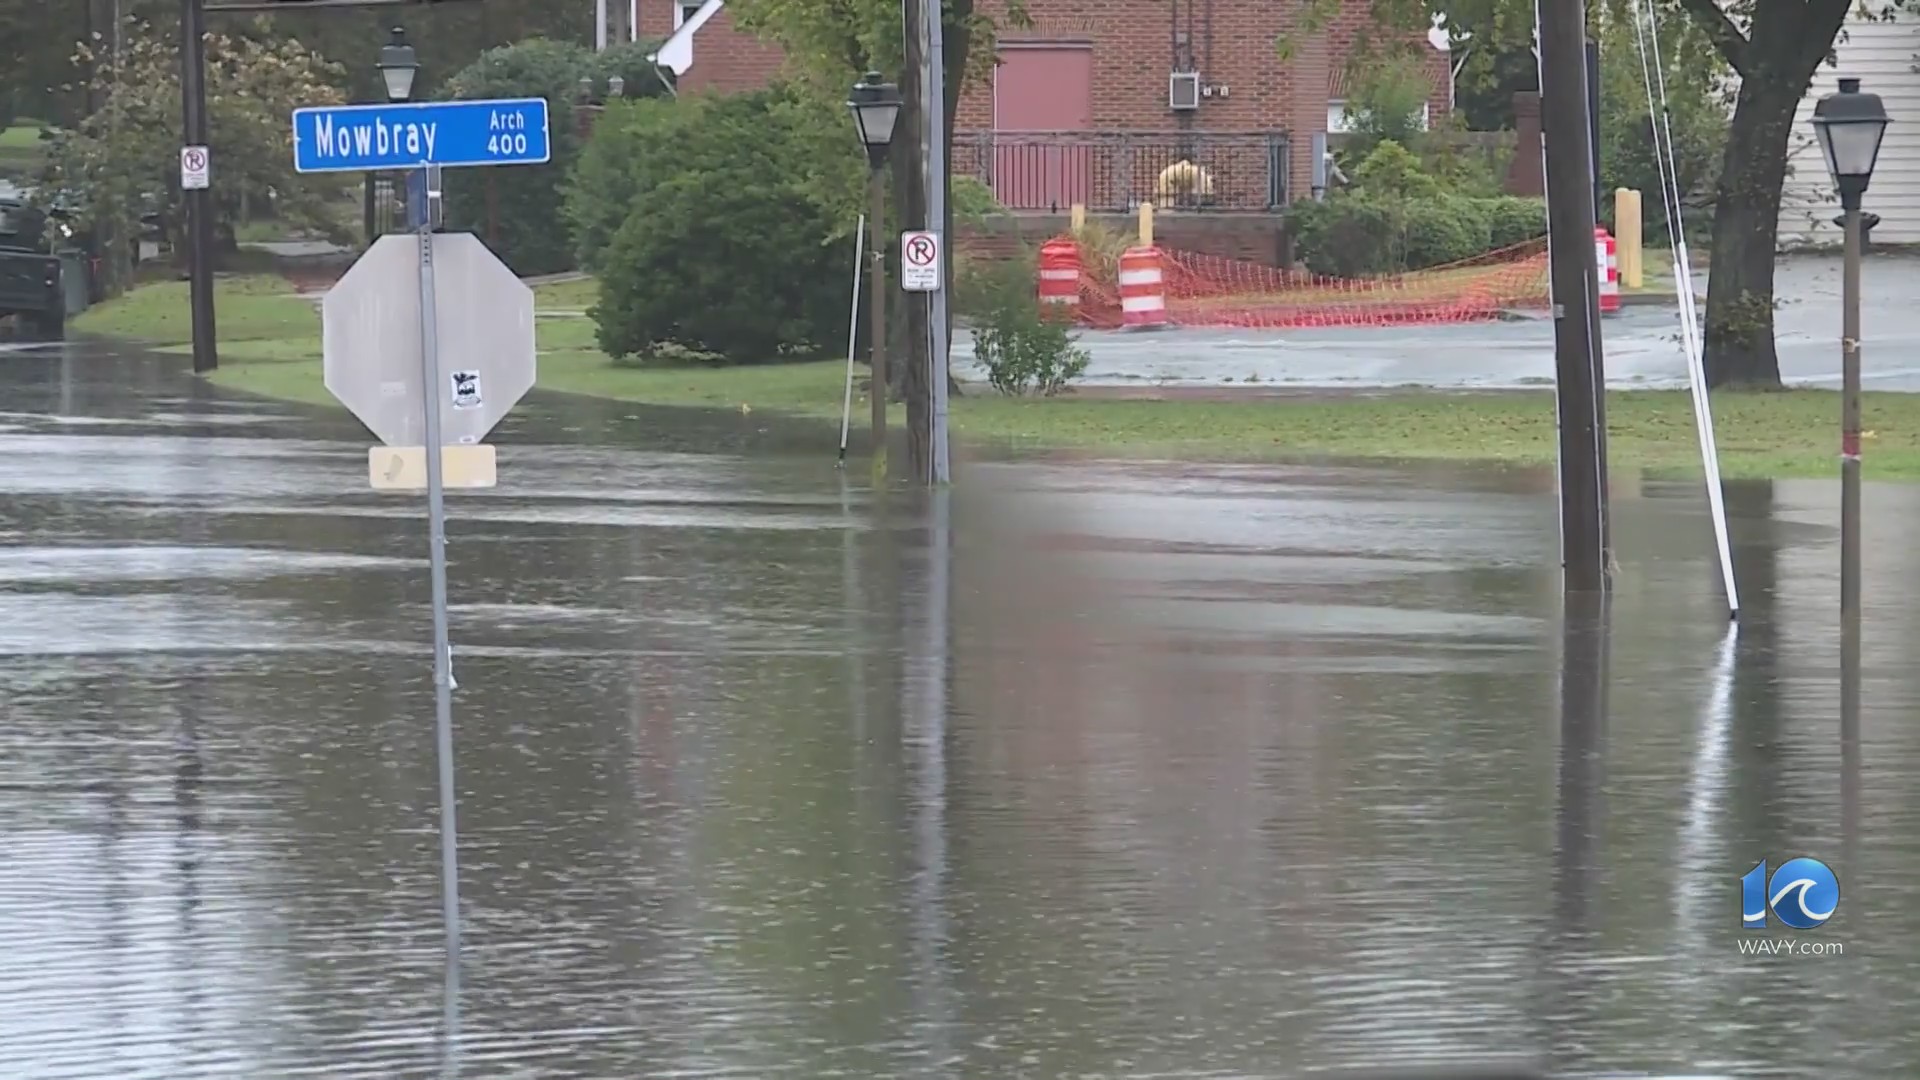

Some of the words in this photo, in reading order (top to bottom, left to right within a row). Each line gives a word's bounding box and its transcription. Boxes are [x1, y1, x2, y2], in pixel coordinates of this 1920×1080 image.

[490, 109, 524, 130] Arch
[315, 114, 437, 160] Mowbray
[487, 133, 527, 155] 400
